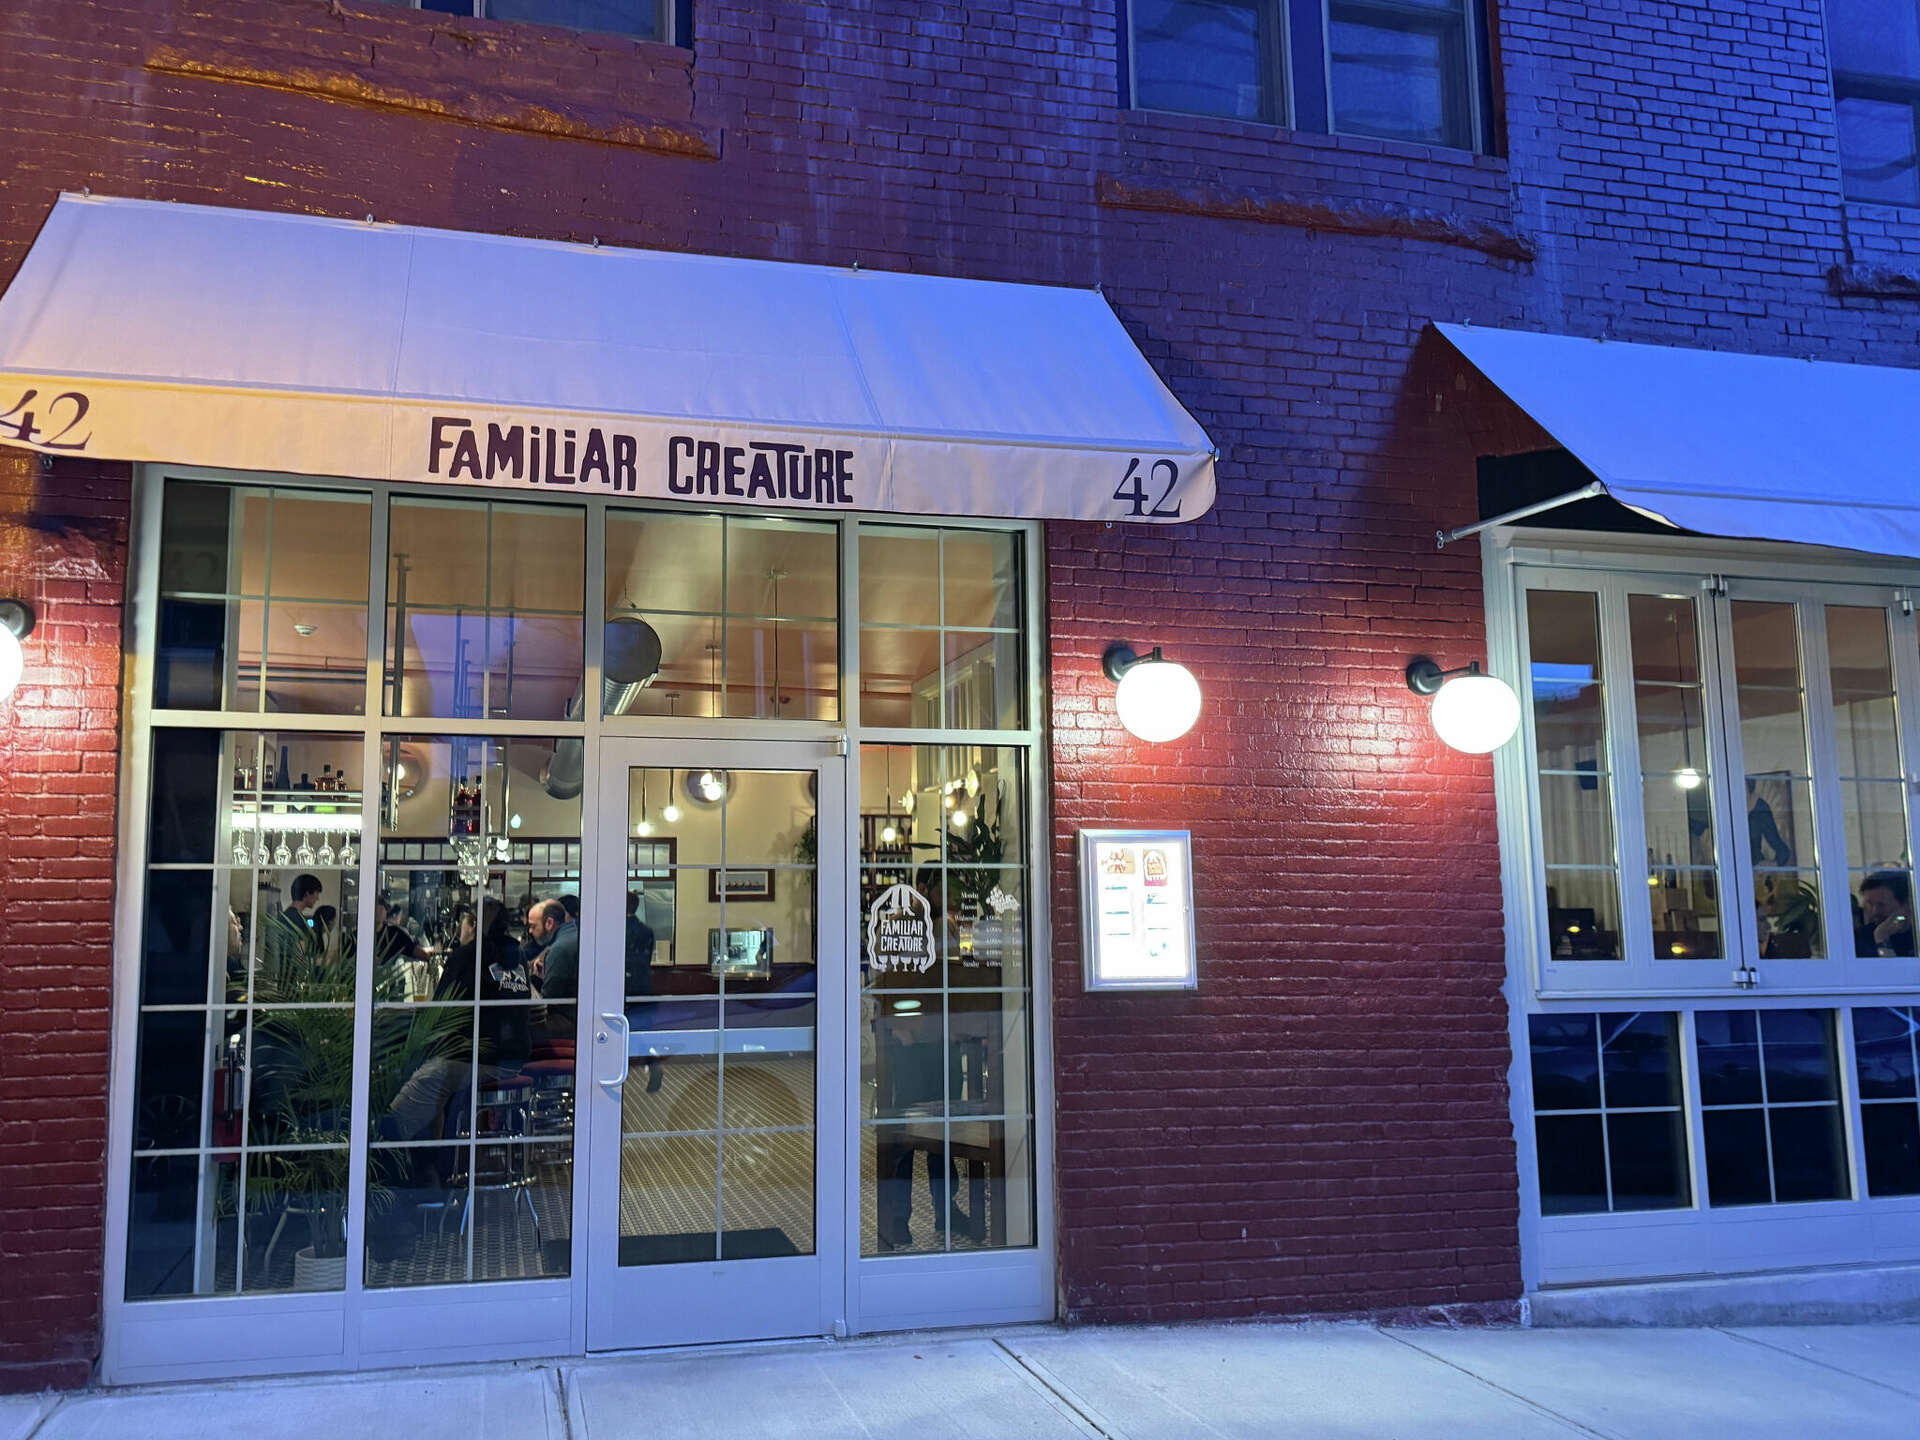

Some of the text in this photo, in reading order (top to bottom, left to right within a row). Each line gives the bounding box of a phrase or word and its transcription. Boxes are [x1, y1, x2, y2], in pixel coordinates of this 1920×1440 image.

[0, 389, 92, 450] 42
[668, 435, 853, 504] CREATURE
[1113, 457, 1181, 518] 42
